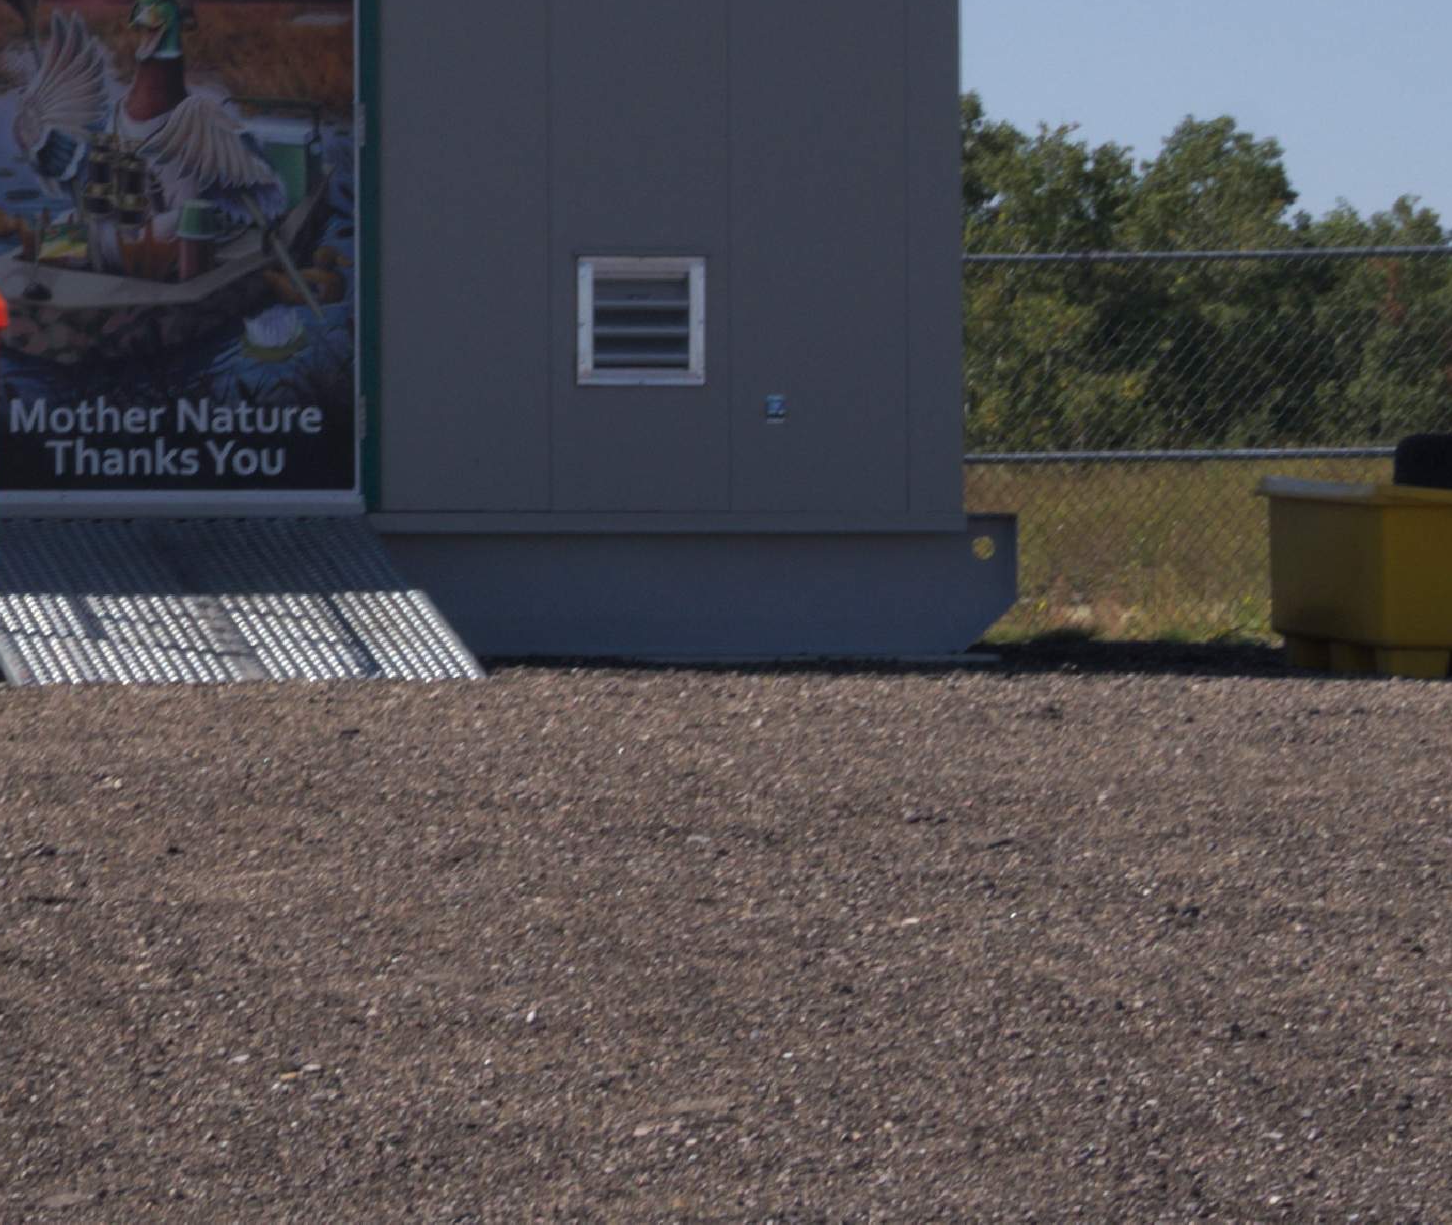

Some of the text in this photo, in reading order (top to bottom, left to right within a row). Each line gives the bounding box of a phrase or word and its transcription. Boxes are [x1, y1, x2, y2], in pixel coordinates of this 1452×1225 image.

[10, 396, 321, 433] Mother Nature
[45, 438, 283, 475] Thanks You
